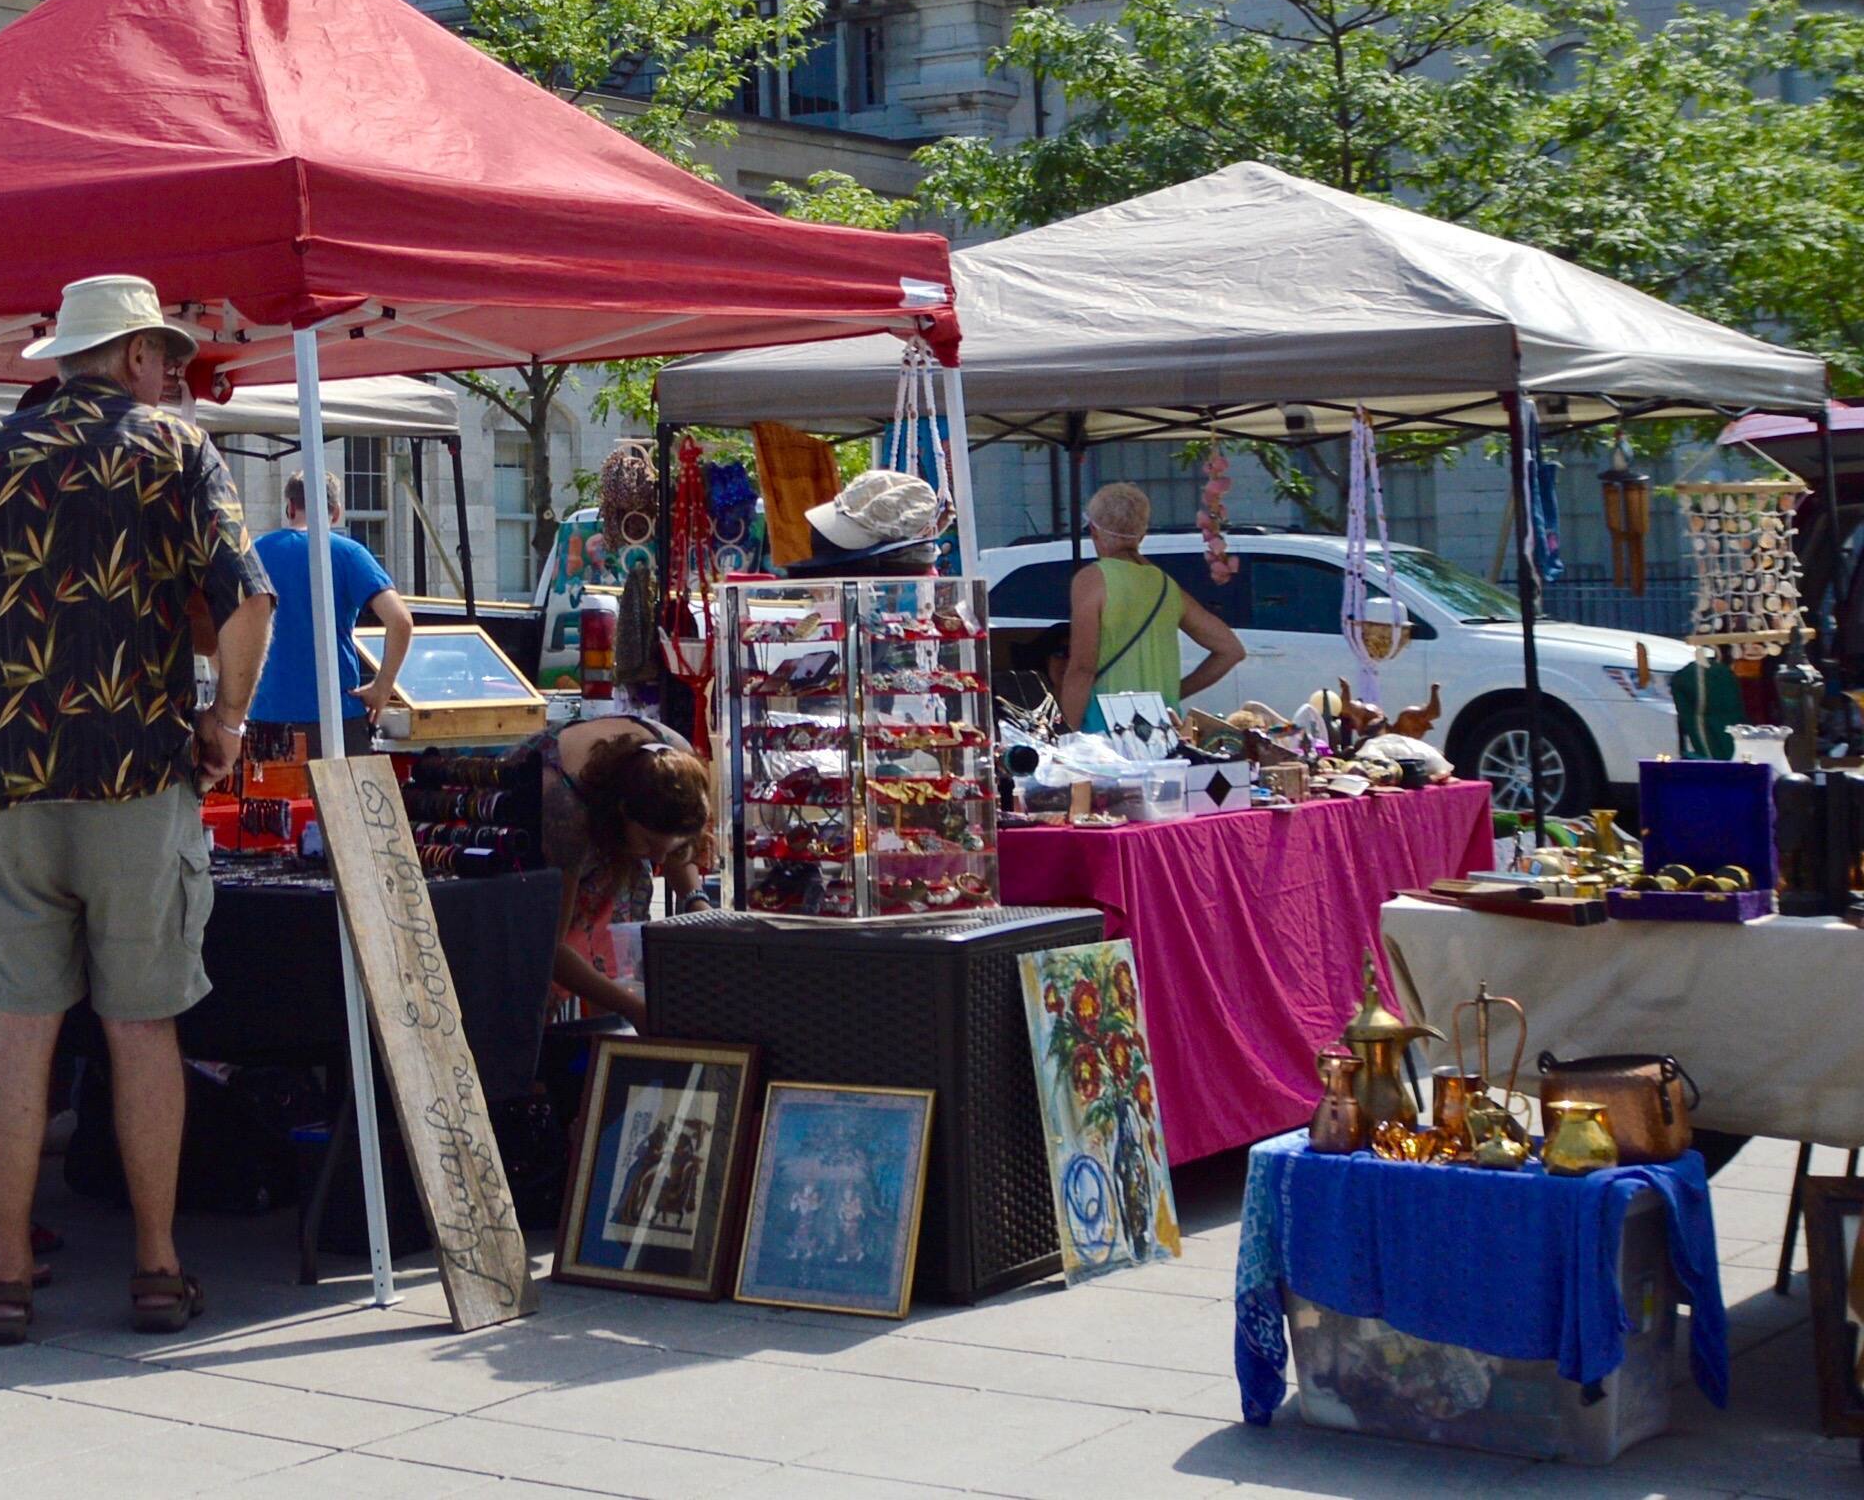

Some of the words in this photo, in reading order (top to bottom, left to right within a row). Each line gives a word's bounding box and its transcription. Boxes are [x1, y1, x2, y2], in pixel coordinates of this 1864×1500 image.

[364, 796, 457, 1037] Goodnight
[453, 1054, 480, 1124] me
[424, 1098, 515, 1307] Always
